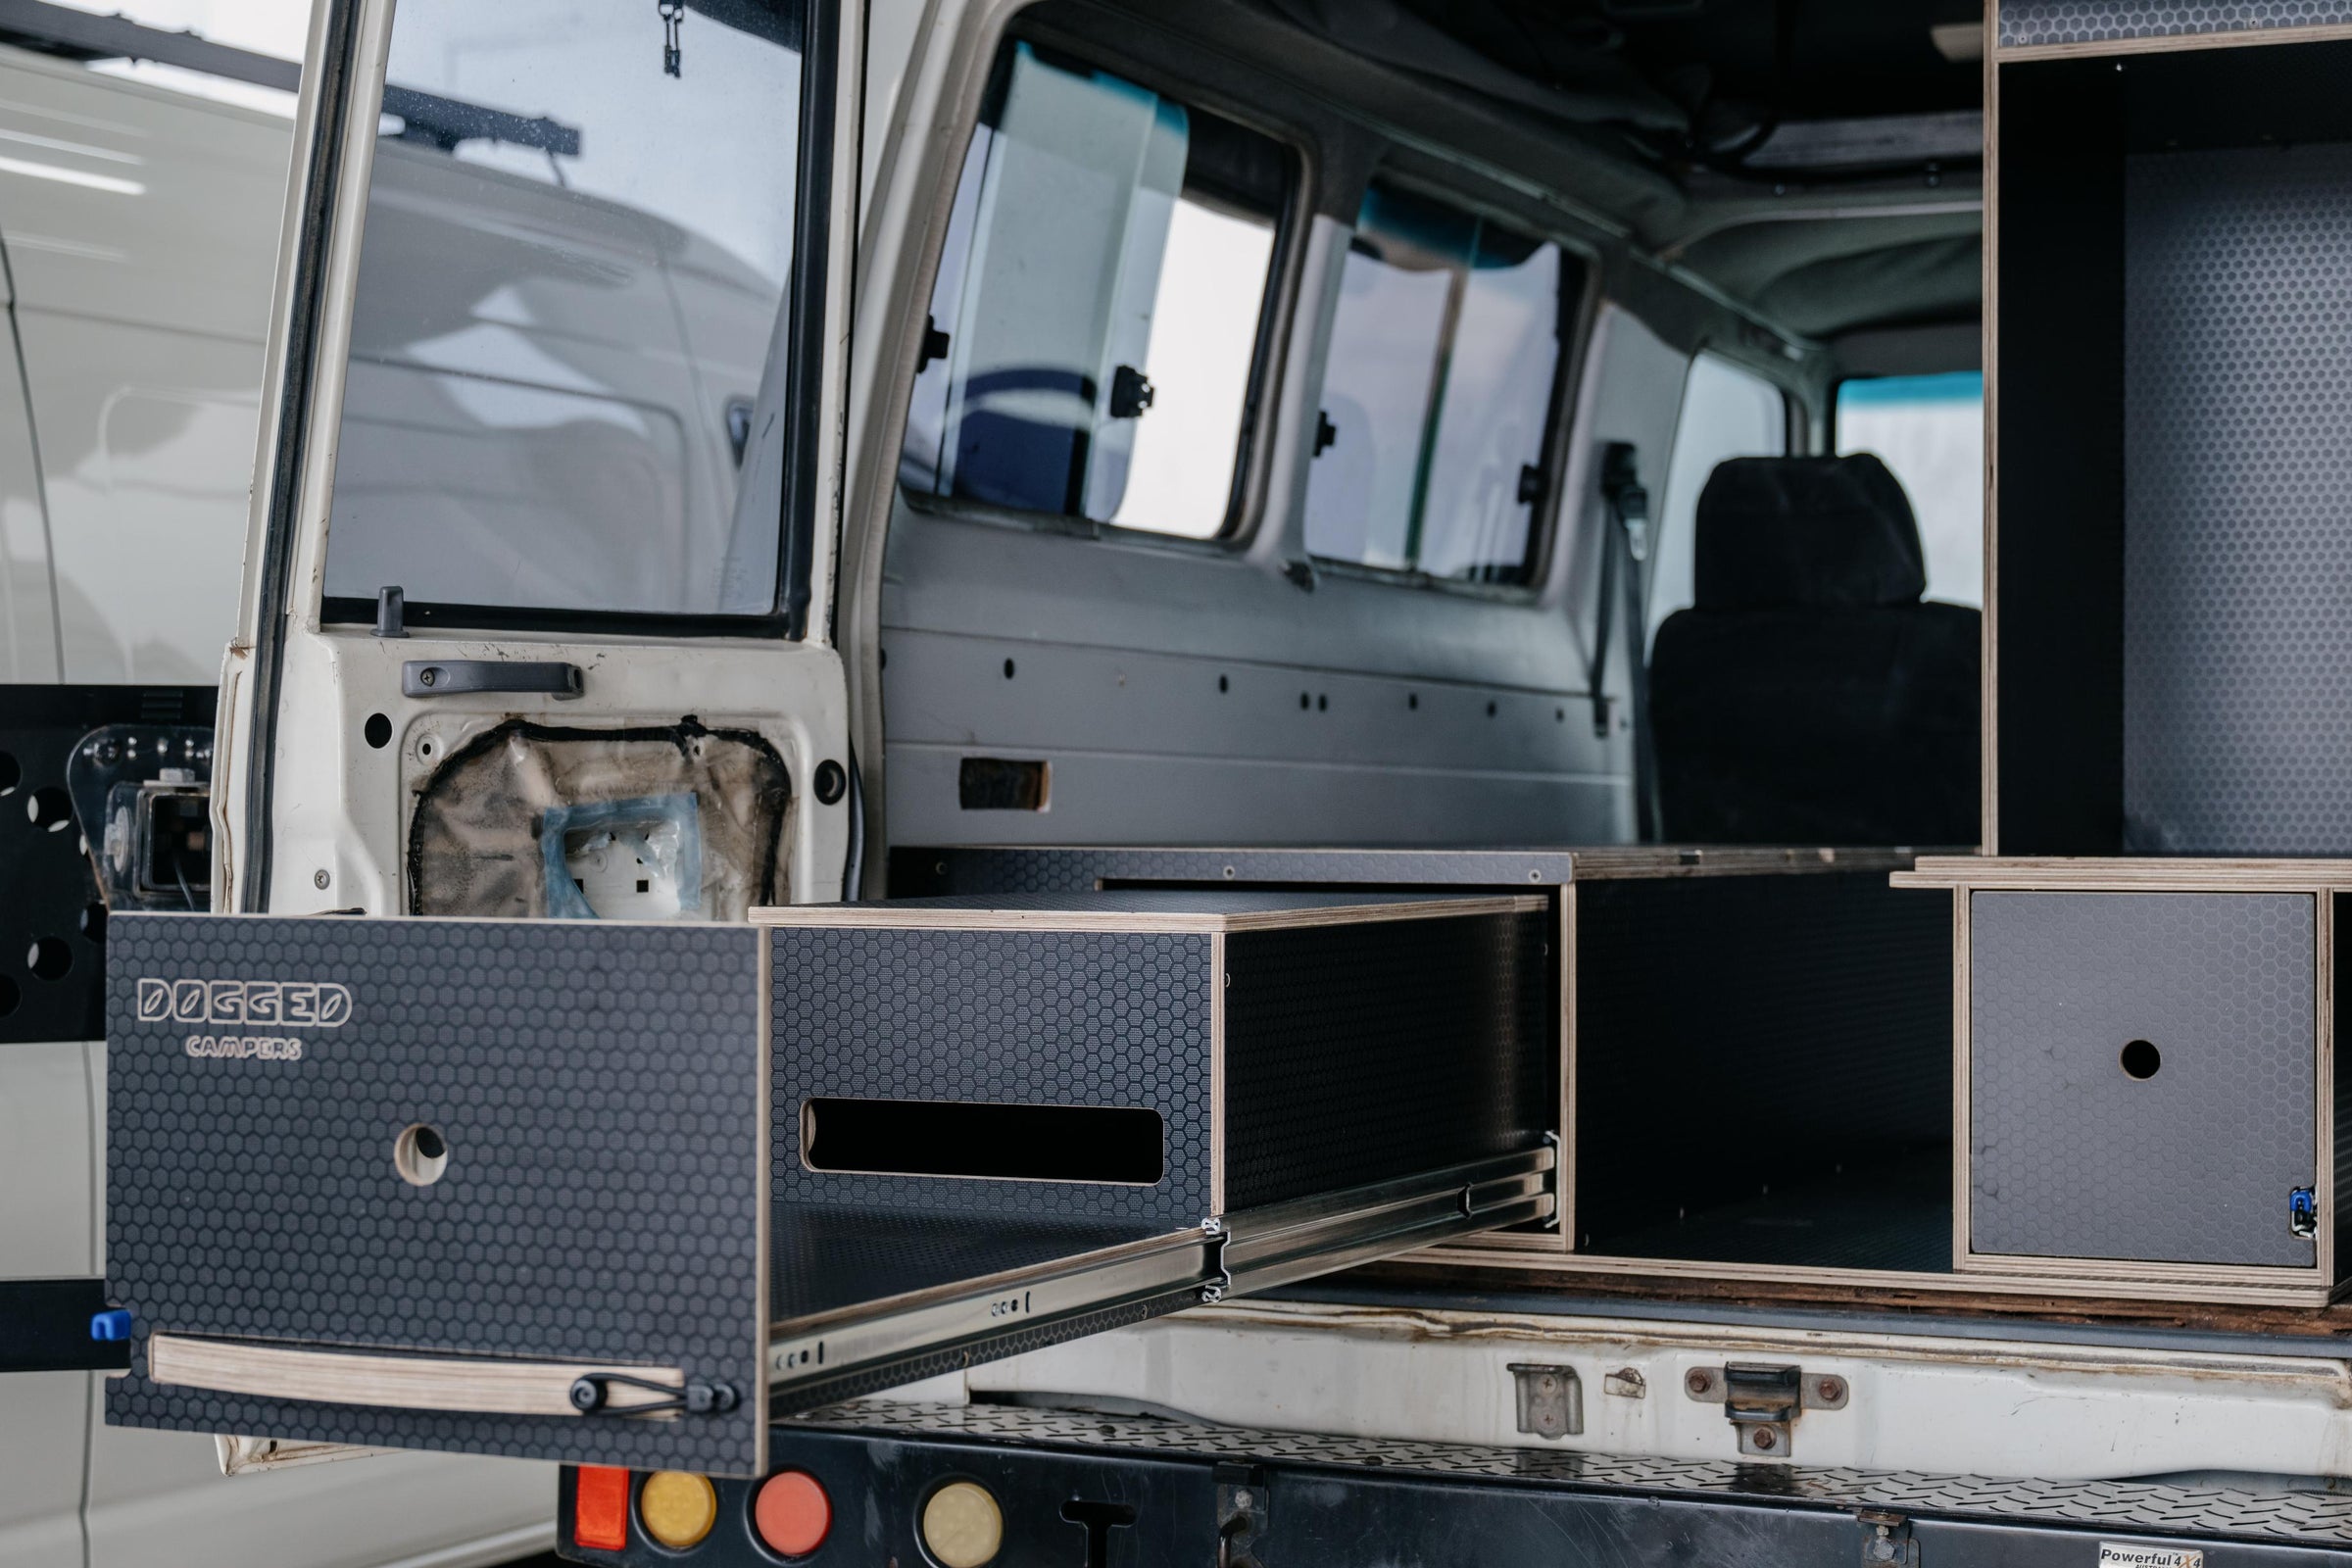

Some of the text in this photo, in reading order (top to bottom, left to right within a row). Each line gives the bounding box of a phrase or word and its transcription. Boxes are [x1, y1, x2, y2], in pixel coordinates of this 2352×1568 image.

[137, 978, 352, 1027] DOGGED
[185, 1035, 302, 1060] CAMPERS
[2100, 1548, 2172, 1566] Powerful
